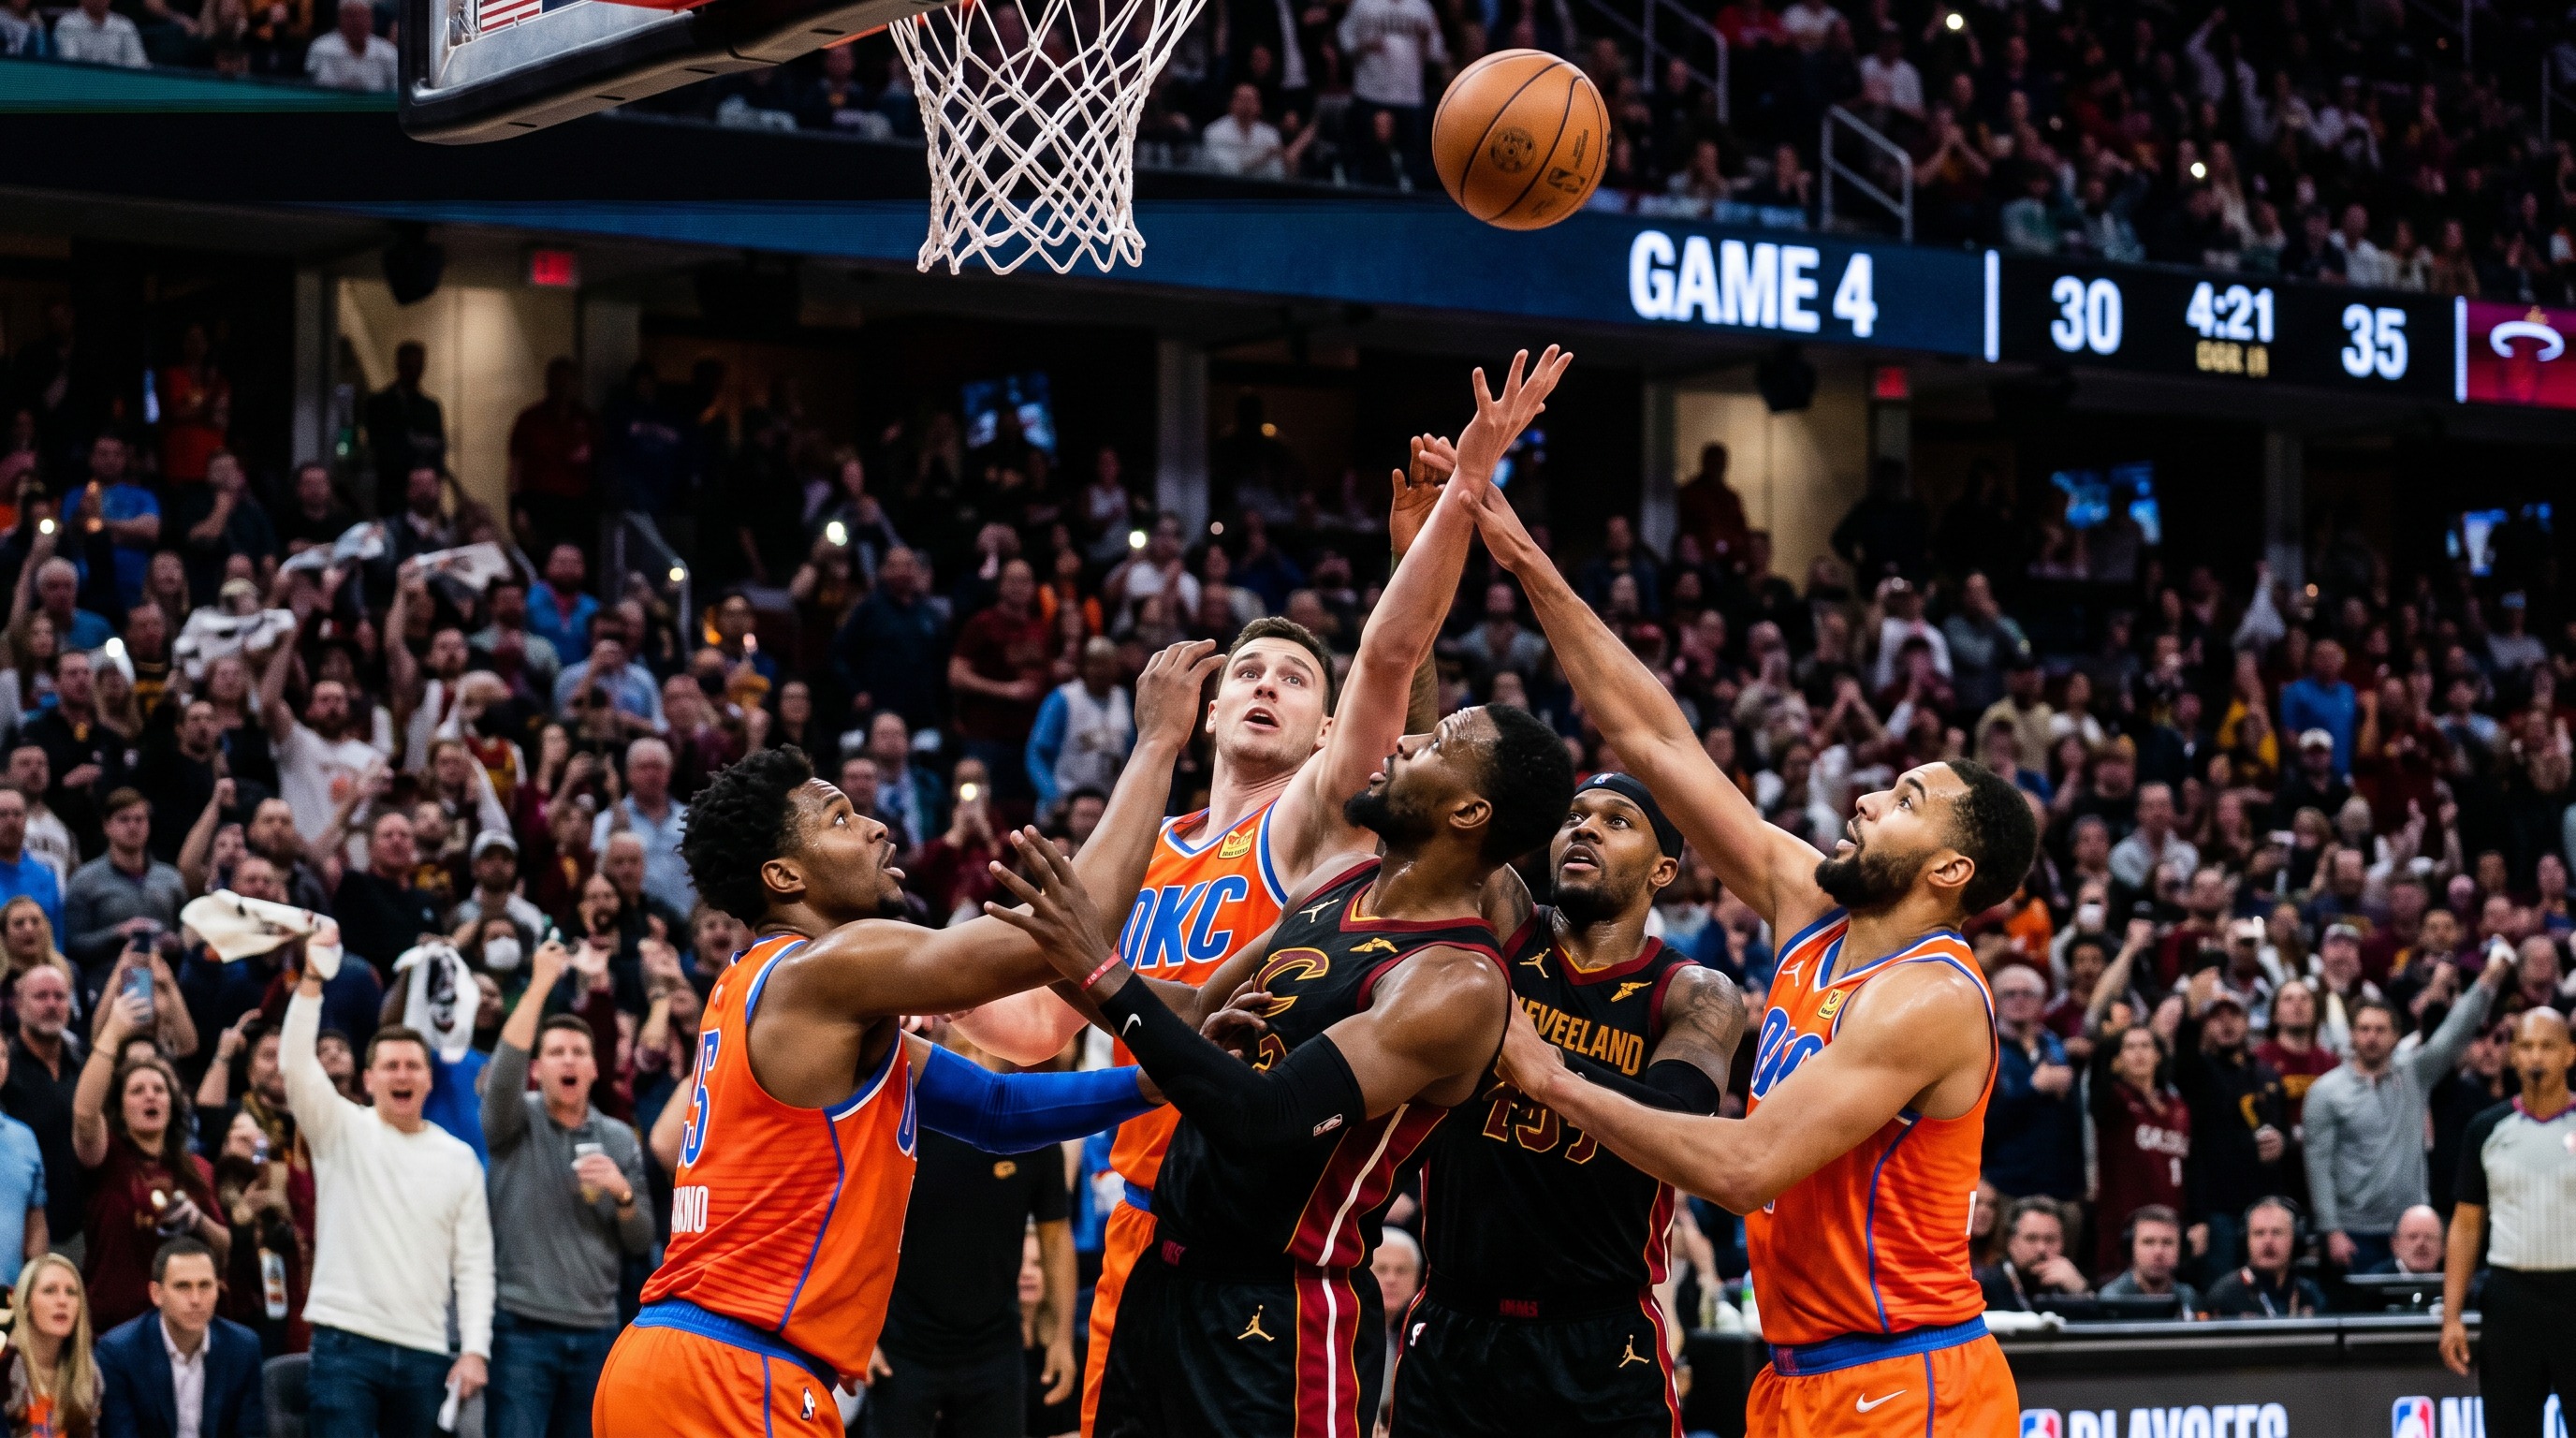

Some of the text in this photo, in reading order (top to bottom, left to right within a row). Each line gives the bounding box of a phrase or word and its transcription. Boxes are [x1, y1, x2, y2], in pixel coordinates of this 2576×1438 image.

[1629, 230, 1878, 338] GAME 4
[2051, 275, 2123, 355] 30
[2185, 281, 2275, 344] 4:21
[2341, 303, 2408, 380] 35
[1119, 874, 1250, 972] OKC
[1518, 996, 1645, 1077] EVEELAND
